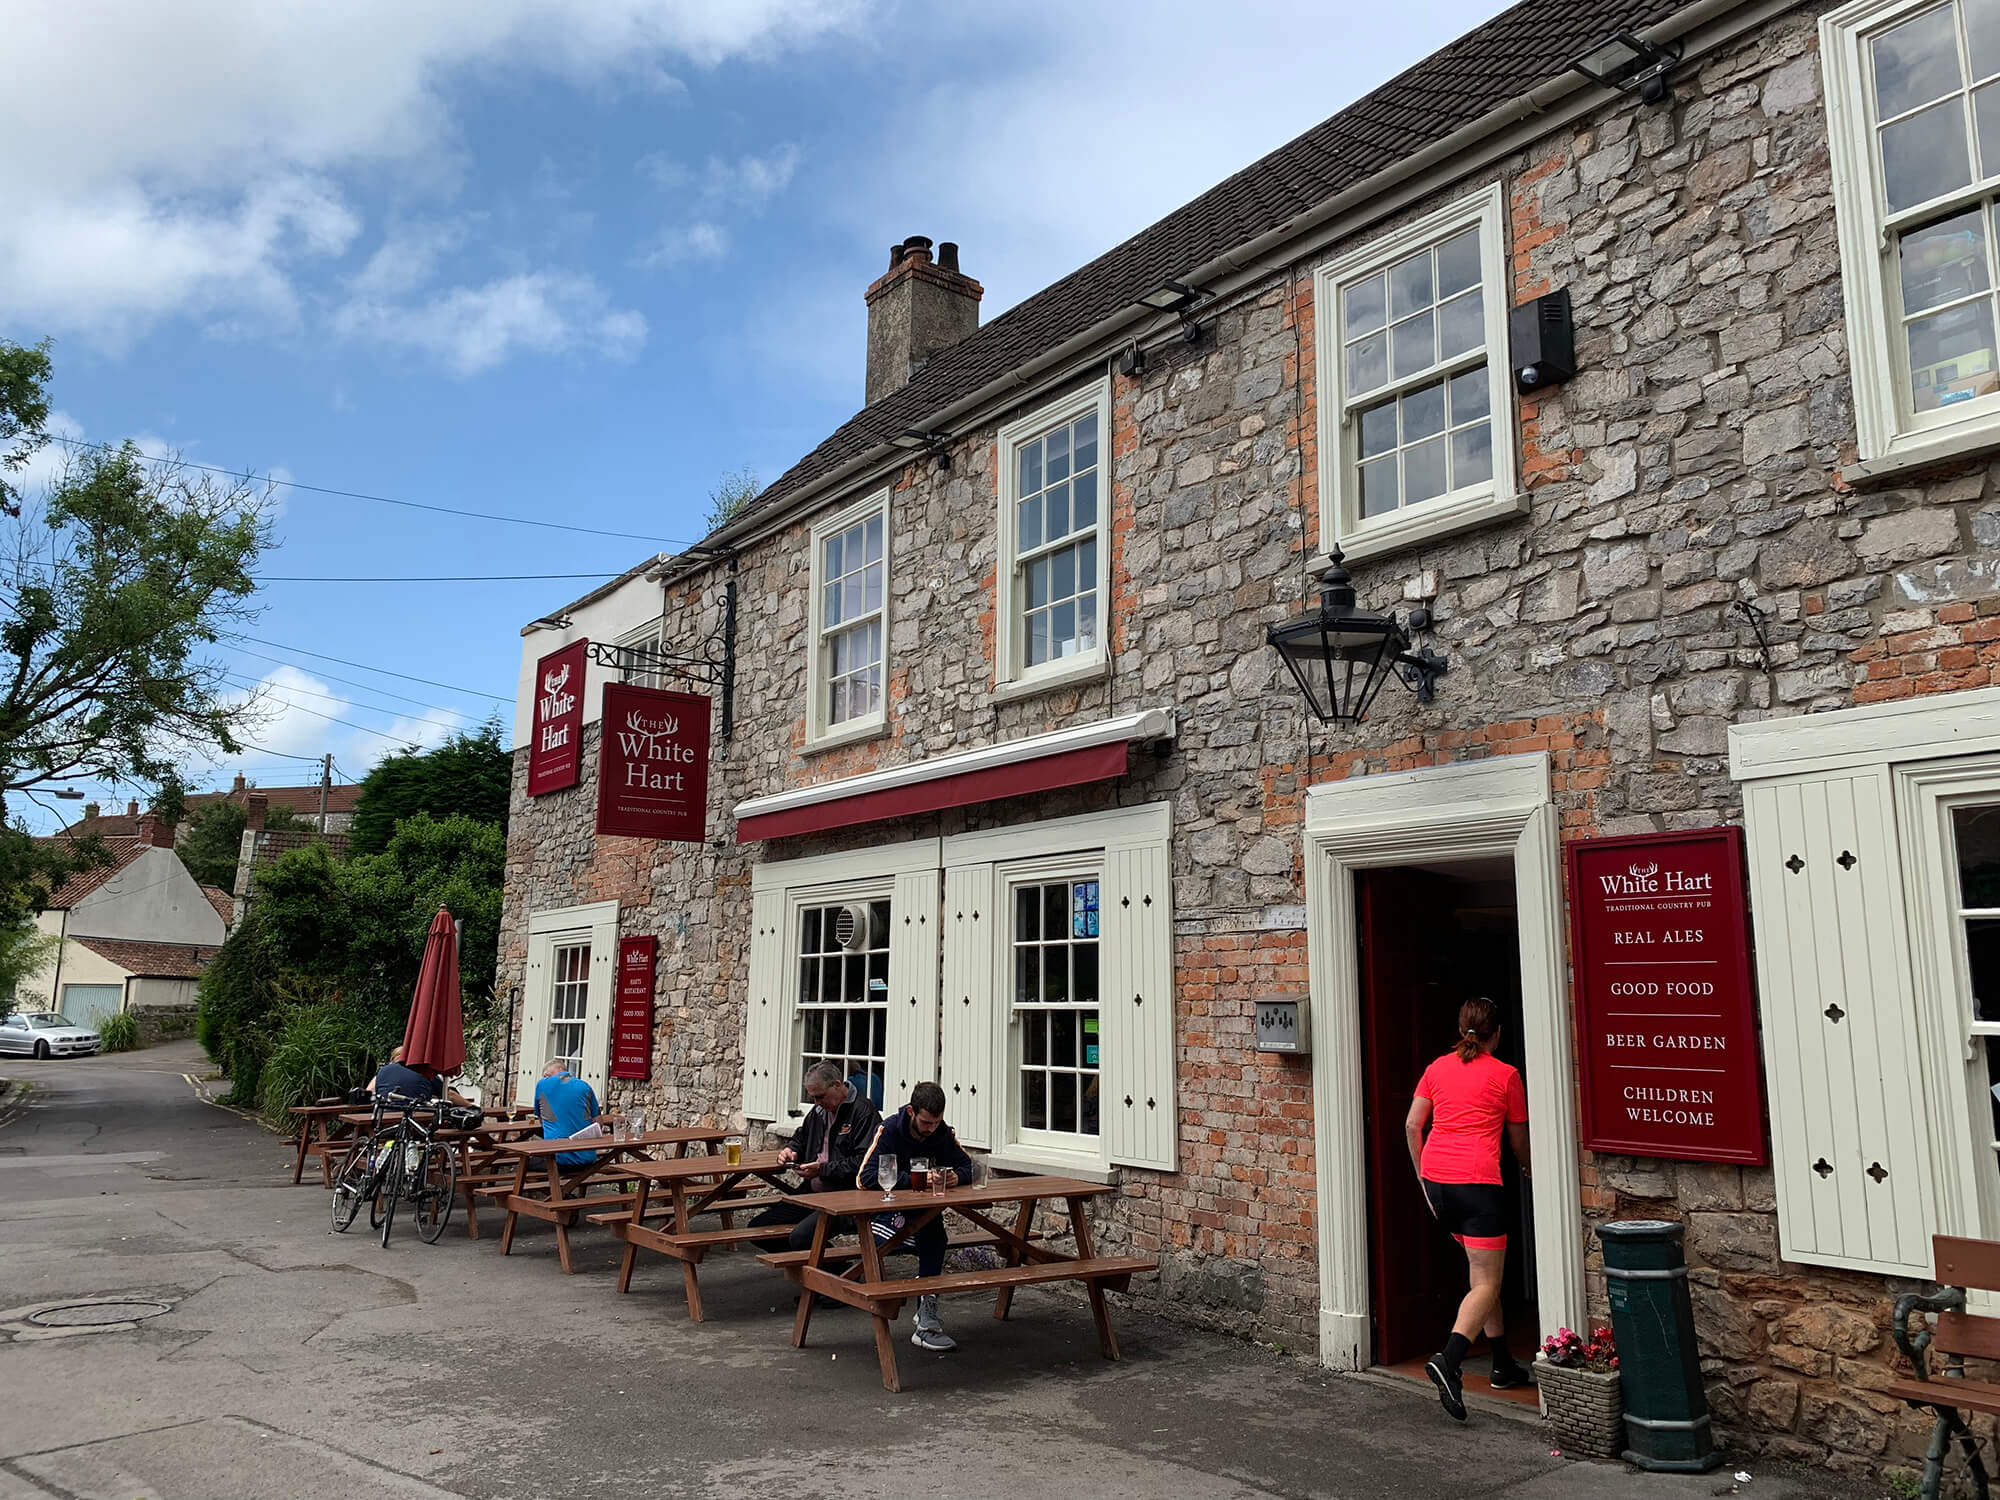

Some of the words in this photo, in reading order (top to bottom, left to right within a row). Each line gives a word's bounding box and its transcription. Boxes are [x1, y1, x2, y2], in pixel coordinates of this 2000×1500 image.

[540, 692, 575, 723] White
[641, 719, 664, 730] THE
[541, 724, 568, 752] Hart
[616, 732, 695, 763] White
[625, 762, 684, 791] Hart
[1599, 874, 1659, 895] White
[1664, 871, 1713, 892] Hart
[1606, 903, 1656, 912] TRADITIONAL
[1657, 901, 1694, 910] COUNTRY
[1614, 931, 1655, 945] REAL
[1663, 929, 1704, 944] ALES
[1610, 982, 1659, 996] GOOD
[1666, 982, 1714, 996] FOOD
[1606, 1034, 1646, 1048] BEER
[1653, 1035, 1727, 1050] GARDEN
[1623, 1086, 1714, 1104] CHILDREN
[1626, 1107, 1715, 1126] WELCOME
